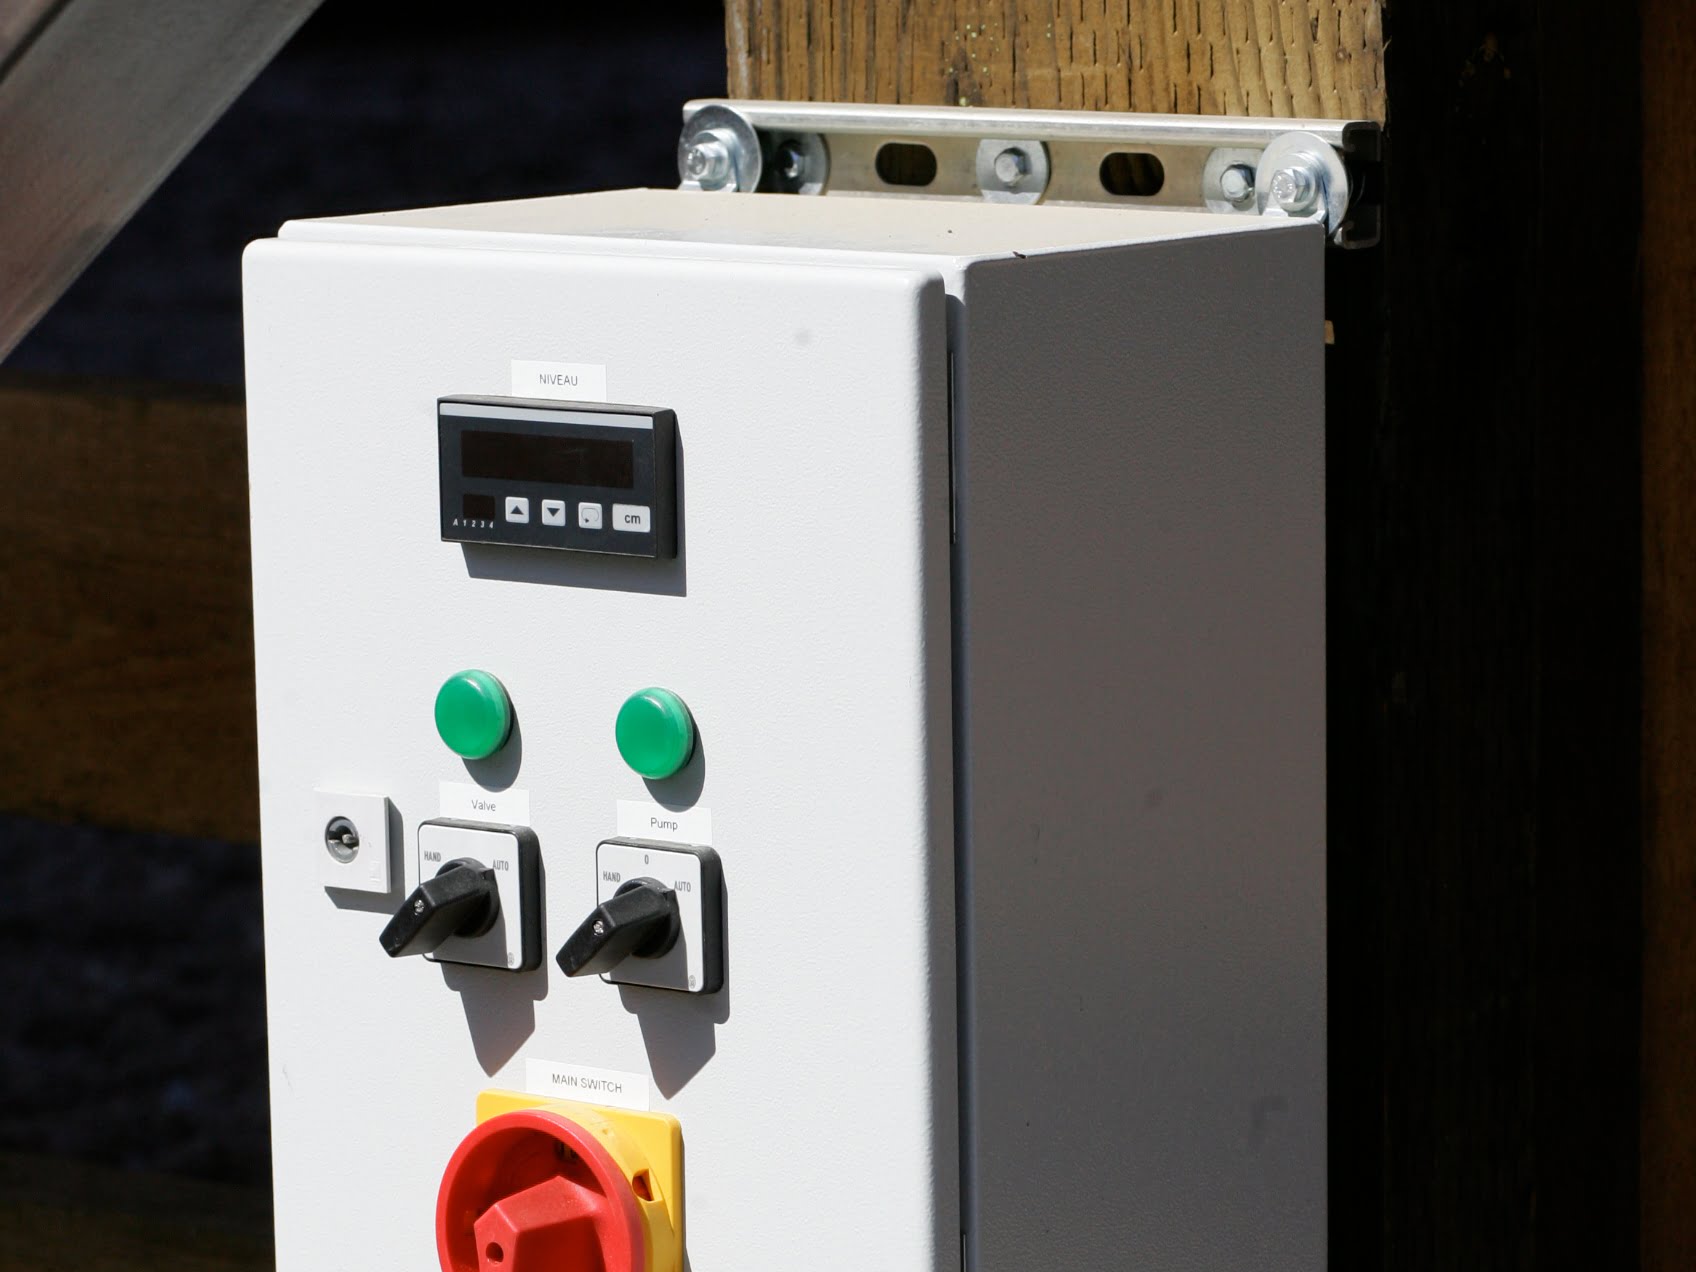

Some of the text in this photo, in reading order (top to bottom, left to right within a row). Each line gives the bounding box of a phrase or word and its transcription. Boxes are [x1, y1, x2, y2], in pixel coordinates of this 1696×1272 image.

[538, 373, 579, 387] NIVEAU
[452, 518, 459, 527] A
[471, 519, 476, 528] 2
[480, 520, 485, 528] 3
[489, 521, 494, 529] 4
[624, 513, 642, 525] cm
[471, 799, 497, 812] Valve
[650, 817, 679, 832] Pump
[424, 850, 442, 862] HAND
[492, 859, 509, 871] AUTO
[602, 870, 621, 883] HAND
[674, 881, 692, 892] AUTO
[552, 1073, 623, 1093] MAIN SWITCH
